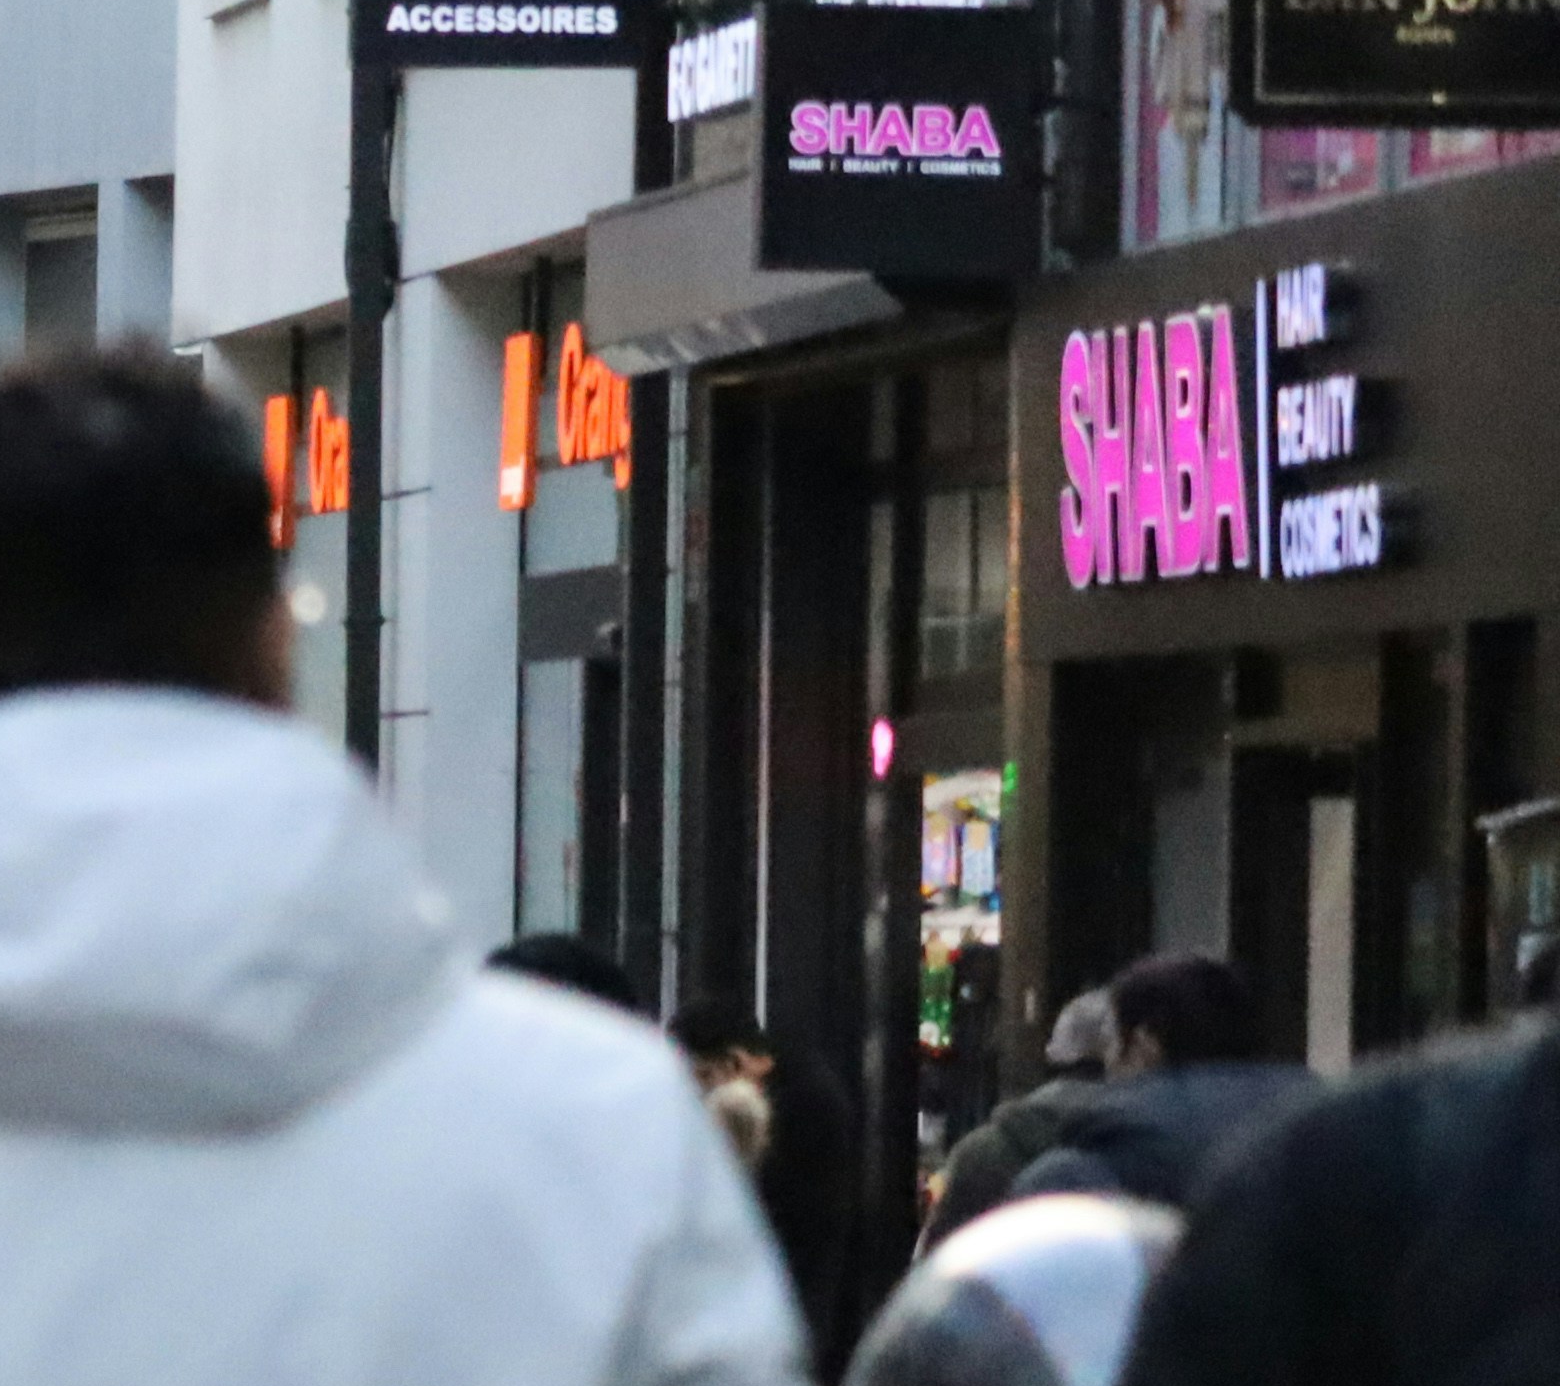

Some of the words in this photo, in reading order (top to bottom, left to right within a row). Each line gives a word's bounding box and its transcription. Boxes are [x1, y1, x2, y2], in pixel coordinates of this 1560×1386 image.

[386, 4, 619, 36] ACCESSOIRES
[789, 99, 1002, 158] SHABA
[1060, 301, 1252, 591] SHABA
[1276, 373, 1357, 467] BEAUTY
[1279, 483, 1383, 581] COSMETICS
